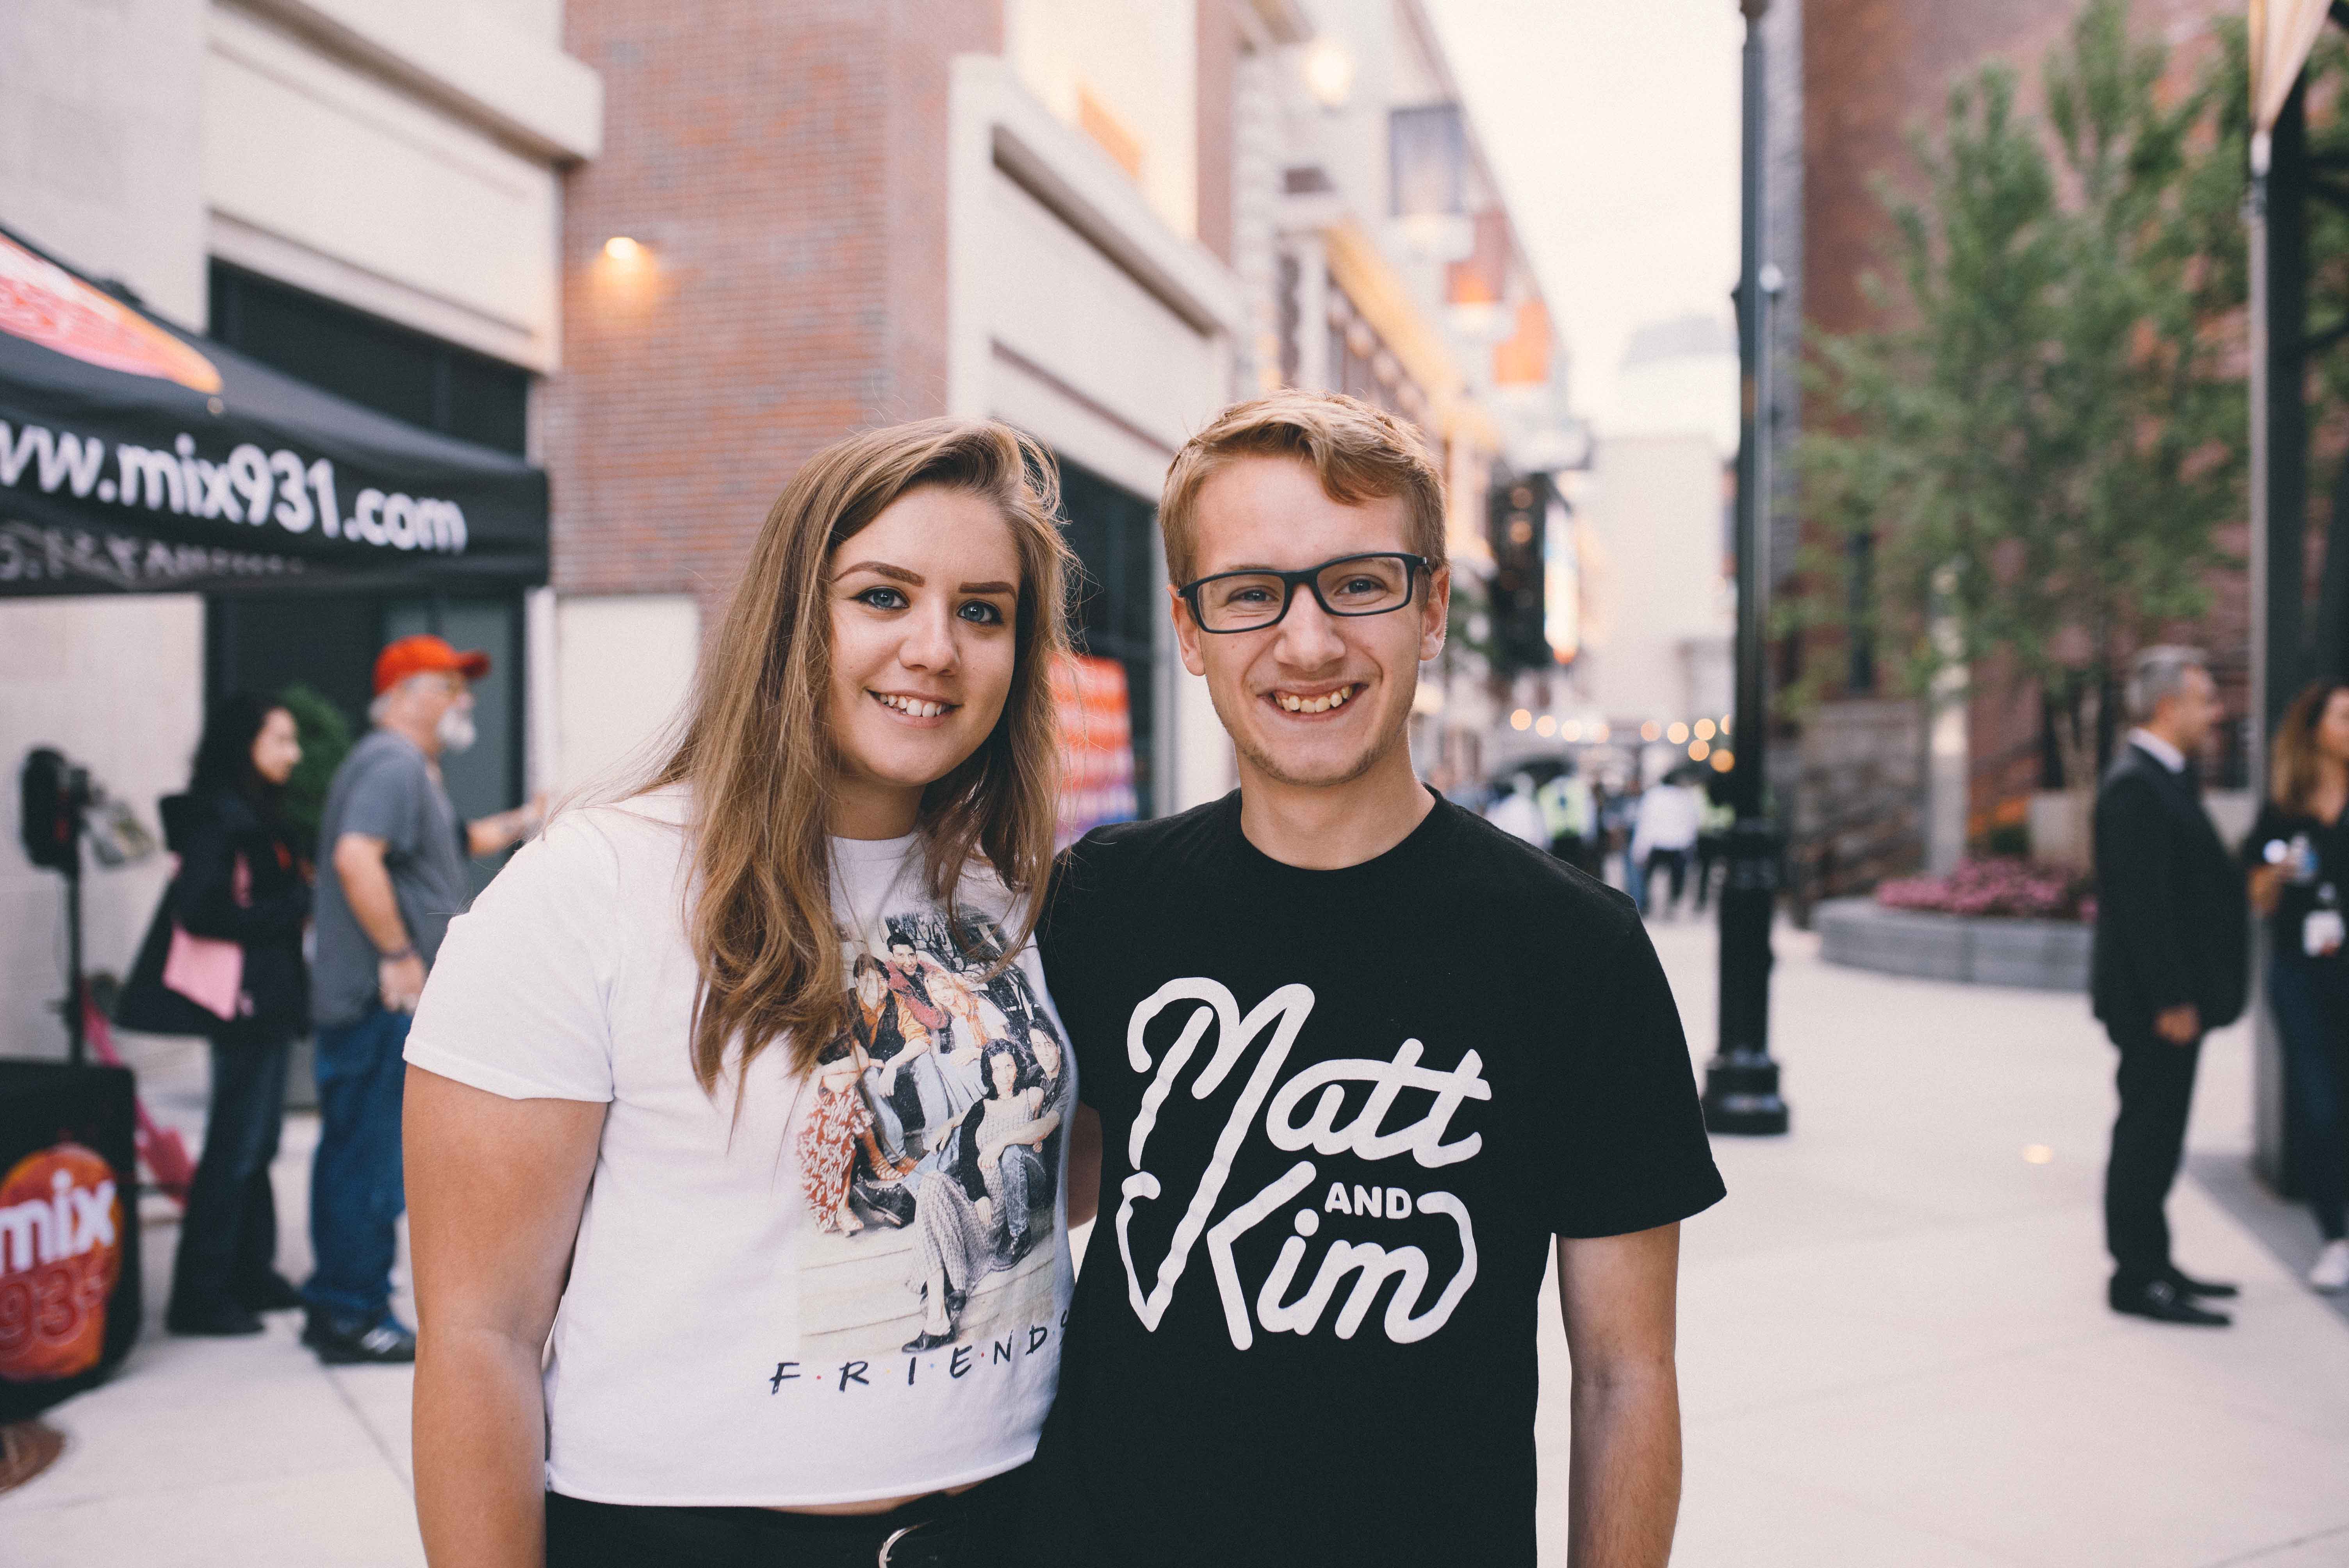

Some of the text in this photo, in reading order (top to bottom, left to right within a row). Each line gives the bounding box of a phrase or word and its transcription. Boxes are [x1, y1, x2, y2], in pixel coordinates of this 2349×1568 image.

[1127, 977, 1492, 1171] Matt
[0, 1169, 116, 1279] mix
[1116, 1160, 1478, 1351] Kim
[1325, 1182, 1412, 1220] AND
